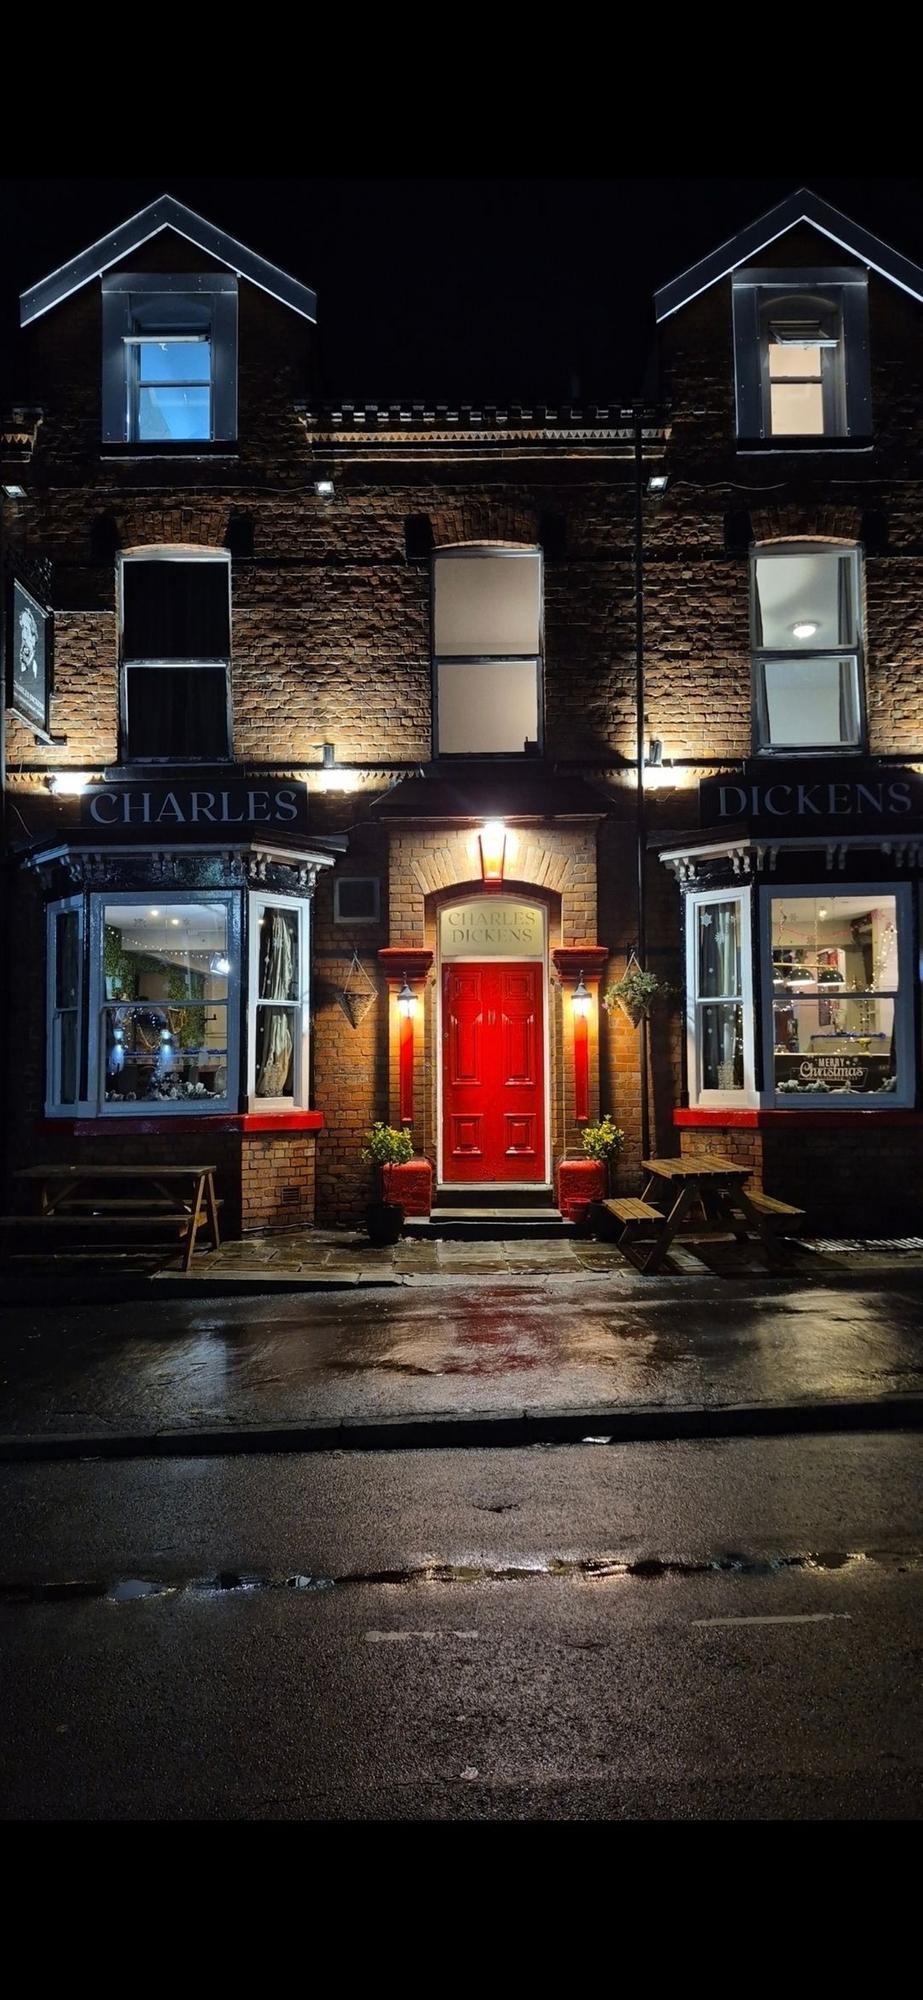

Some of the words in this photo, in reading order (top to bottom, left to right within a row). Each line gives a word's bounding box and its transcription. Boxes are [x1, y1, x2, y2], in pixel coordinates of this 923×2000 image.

[90, 790, 298, 824] CHARLES
[718, 782, 913, 816] DICKENS
[448, 911, 536, 926] CHARLES
[452, 928, 533, 943] DICKENS
[799, 1061, 864, 1078] Christmas
[818, 1057, 845, 1067] MERRY
